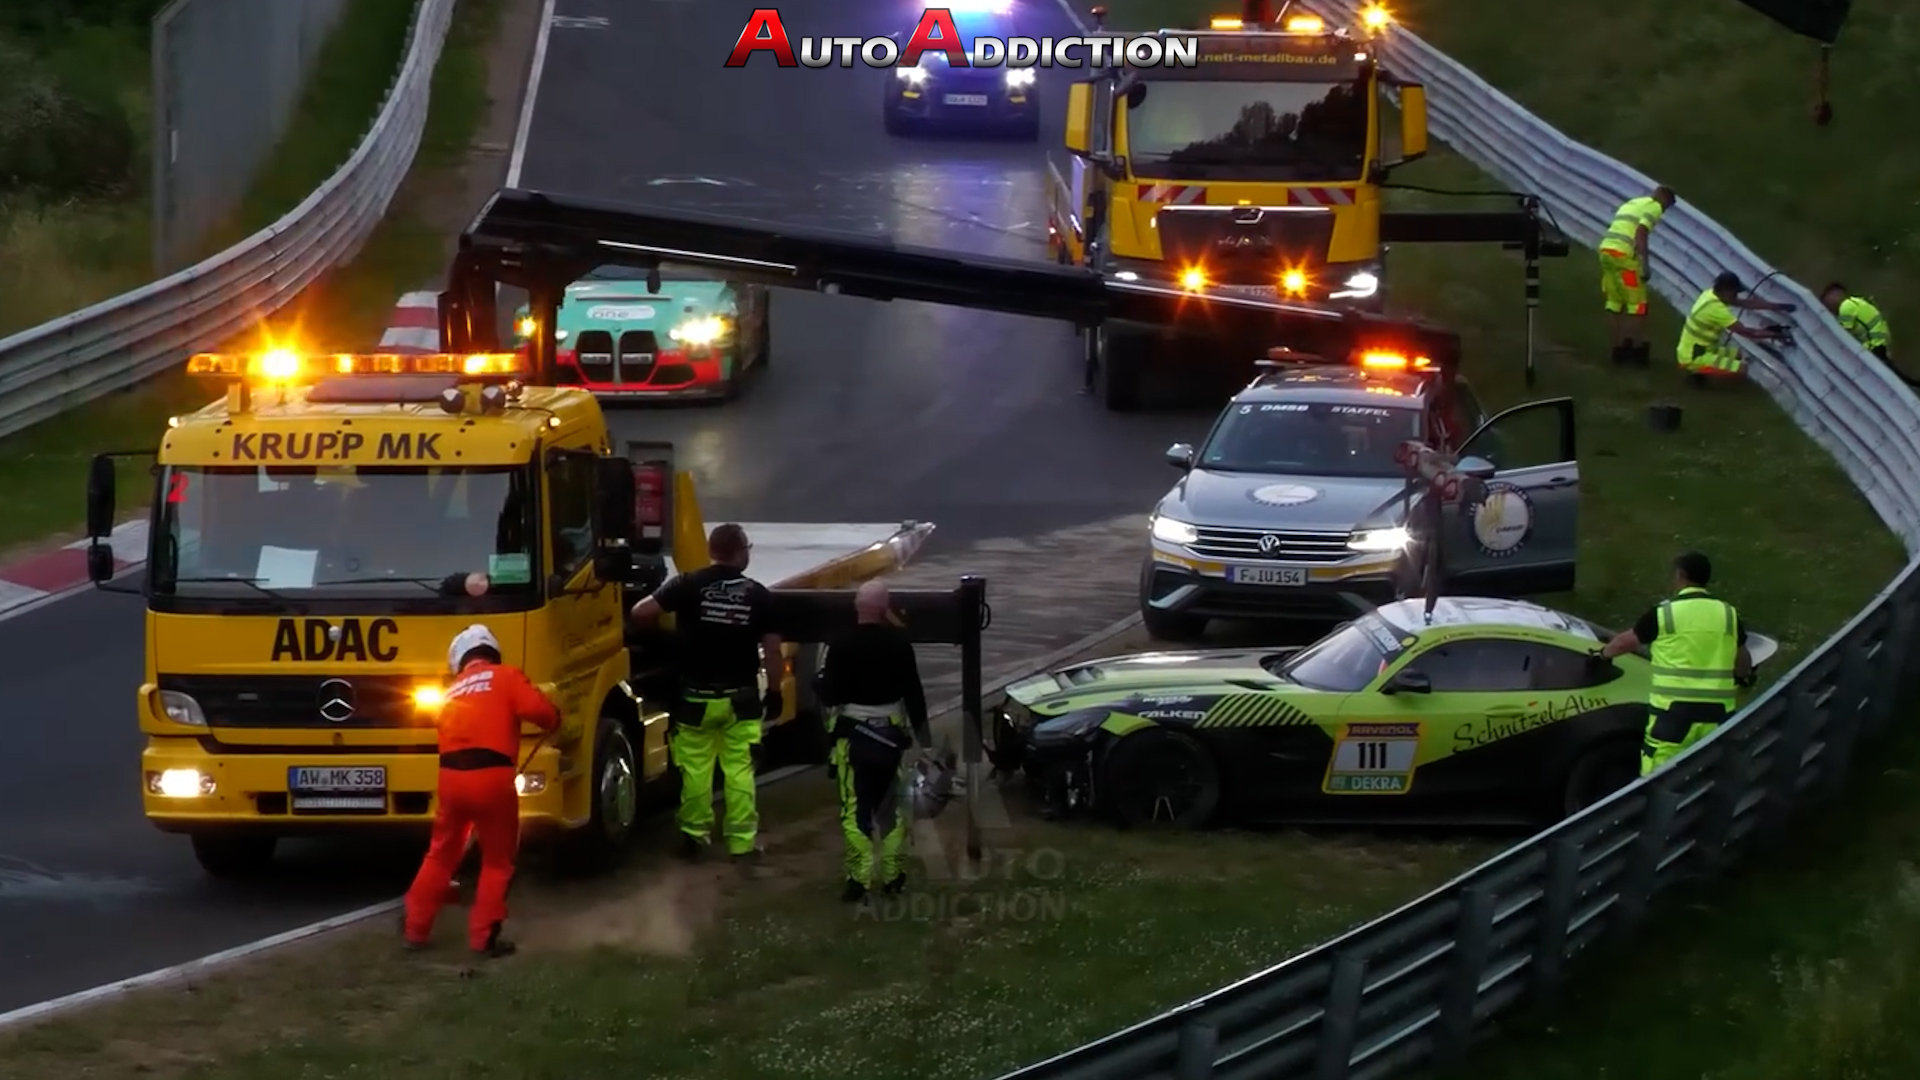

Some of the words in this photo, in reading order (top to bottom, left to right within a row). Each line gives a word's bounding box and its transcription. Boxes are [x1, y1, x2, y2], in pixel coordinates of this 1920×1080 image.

[1239, 404, 1253, 414] 5
[1260, 404, 1309, 412] DMSB
[1331, 405, 1391, 417] STAFFEL
[232, 433, 364, 460] KRUPP
[377, 433, 442, 461] MK
[168, 473, 189, 502] 2
[270, 618, 399, 662] ADAC
[1138, 711, 1207, 720] FALKEN
[1351, 725, 1415, 735] RAVENOL
[1358, 742, 1387, 769] 111
[354, 769, 383, 785] 358
[1351, 776, 1402, 790] DEKRA
